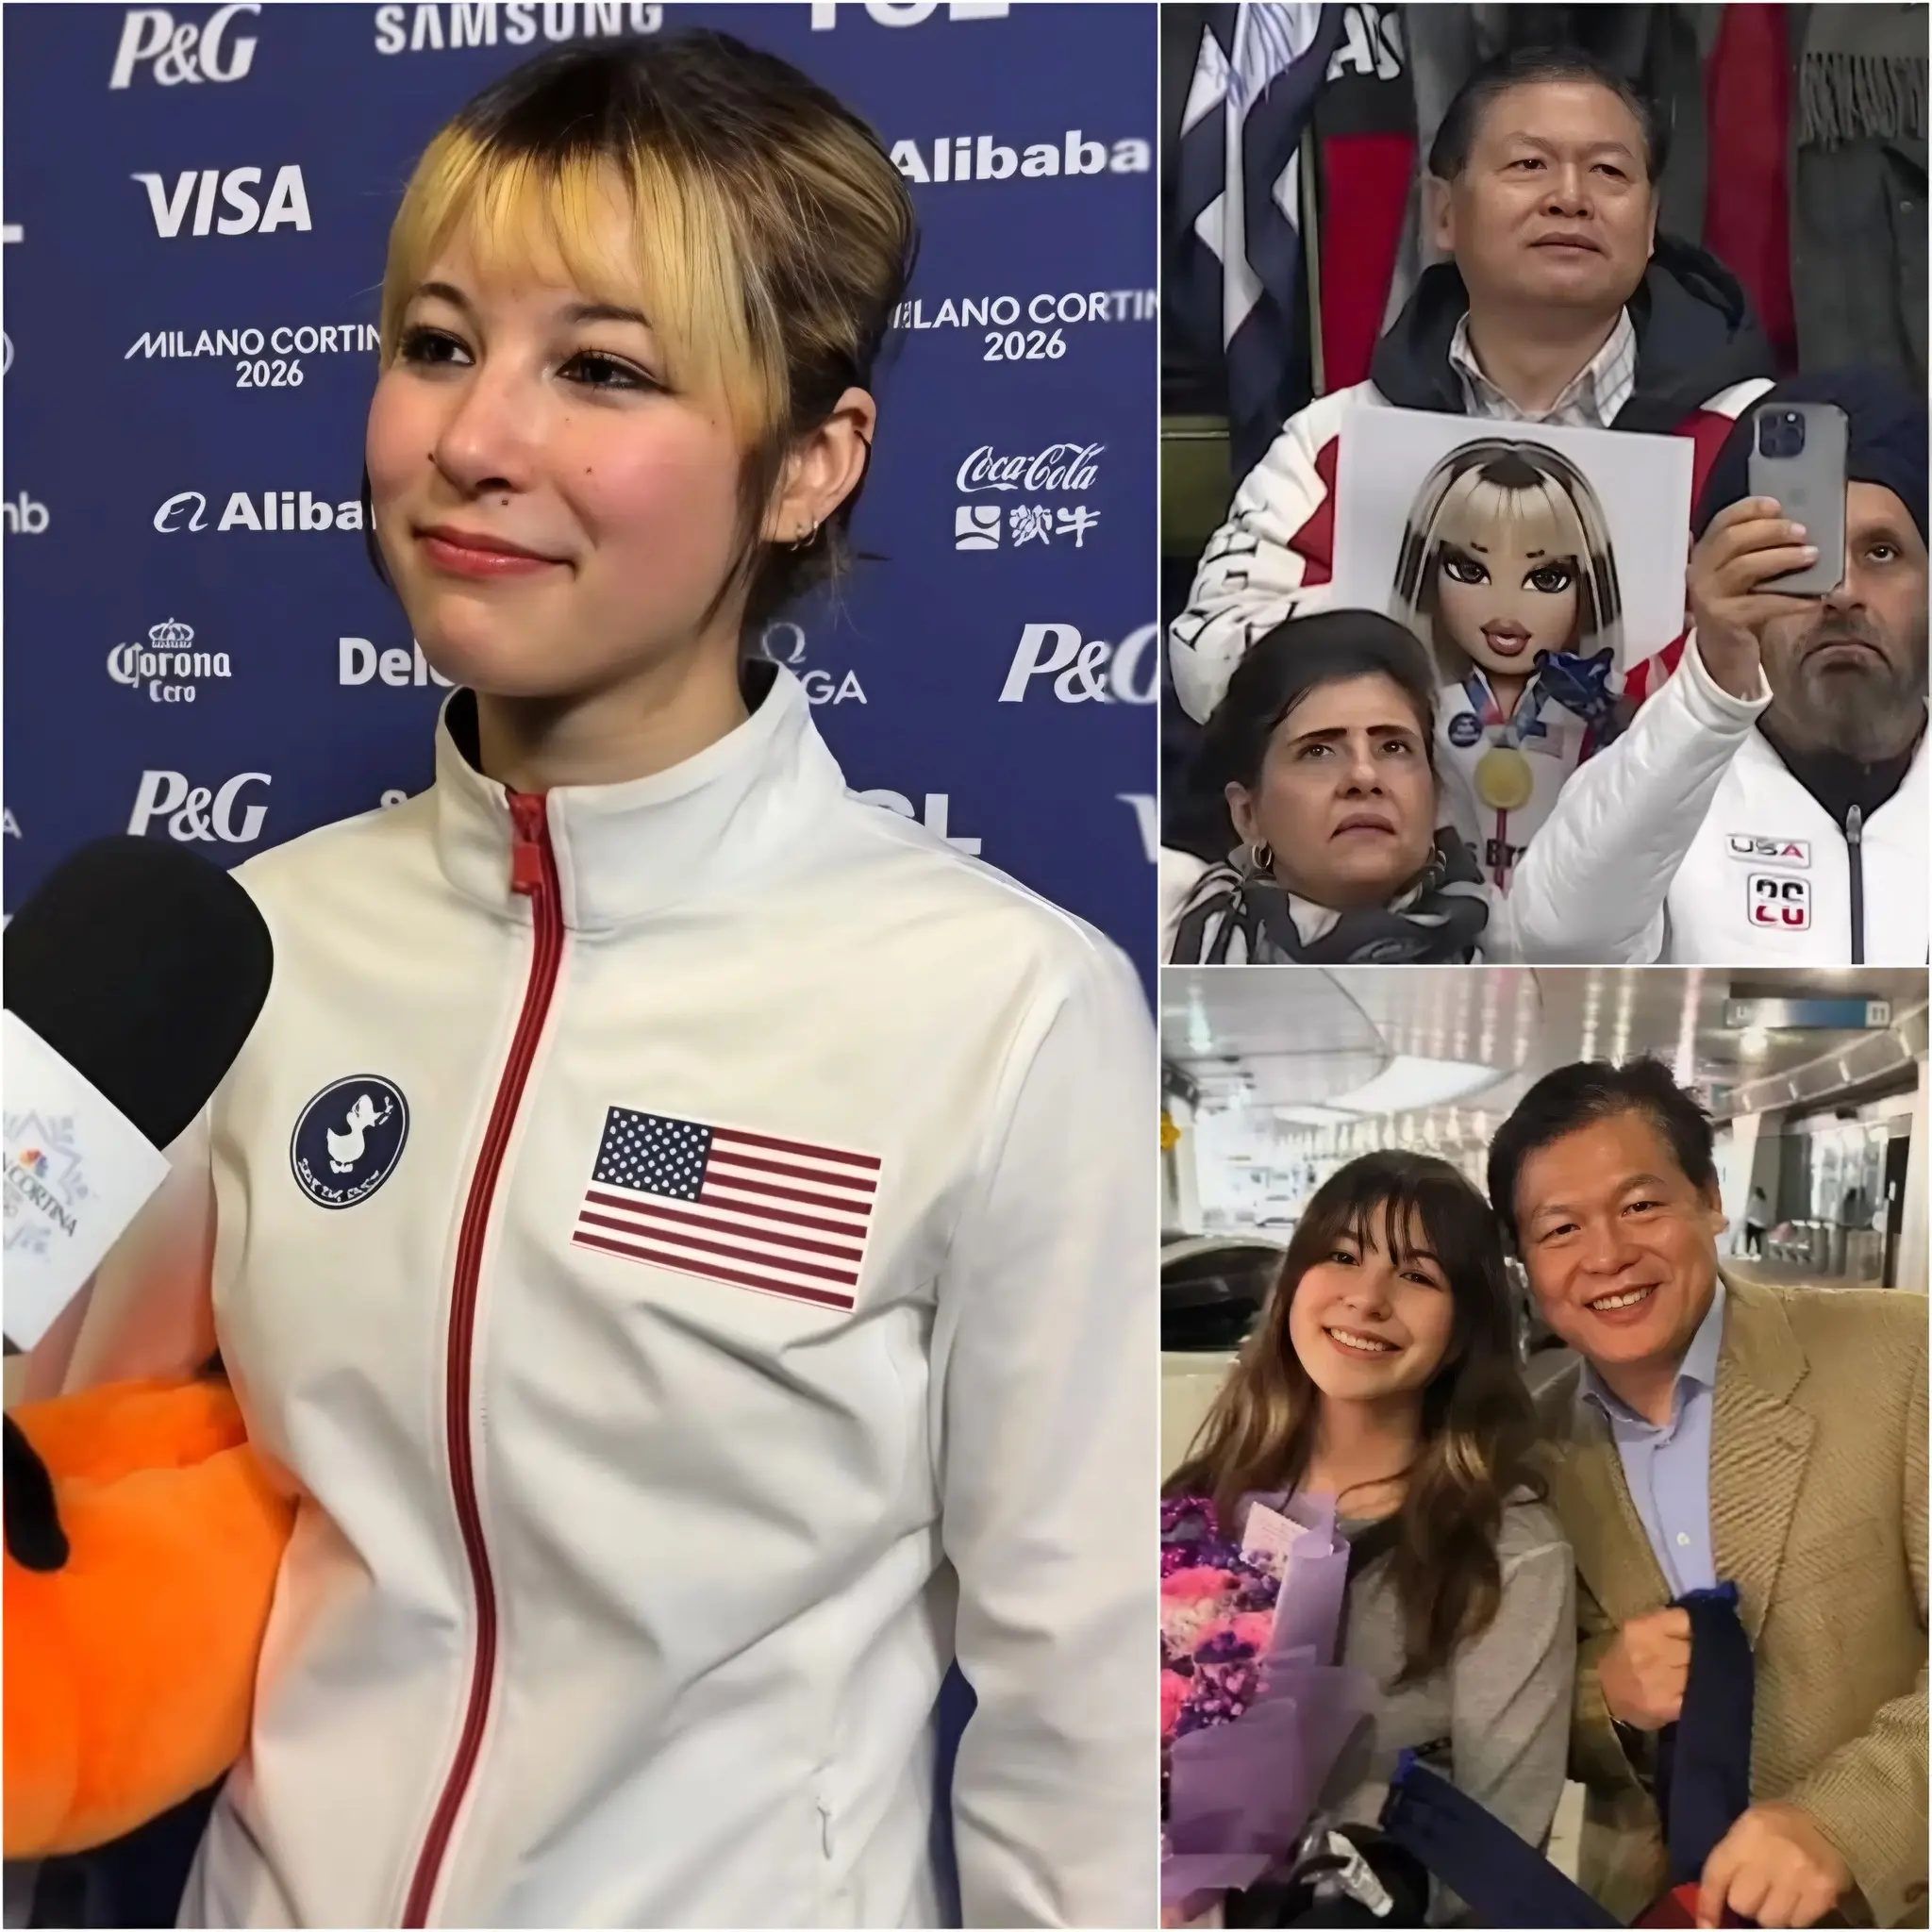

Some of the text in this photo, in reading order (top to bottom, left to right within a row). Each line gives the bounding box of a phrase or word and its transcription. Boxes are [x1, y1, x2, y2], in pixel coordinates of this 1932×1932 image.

[109, 4, 261, 89] P&G
[375, 3, 663, 54] SAMSUNG
[889, 130, 1151, 183] Alibaba
[132, 164, 312, 239] VISA
[893, 296, 1021, 328] ILANO
[124, 328, 265, 360] MILANO
[983, 328, 1067, 361] 2026
[236, 358, 304, 388] 2026
[956, 442, 1105, 492] Coca-Cola
[217, 491, 376, 531] Aliba
[107, 641, 232, 689] Corona
[127, 770, 272, 843] P&G
[1731, 838, 1805, 859] USA
